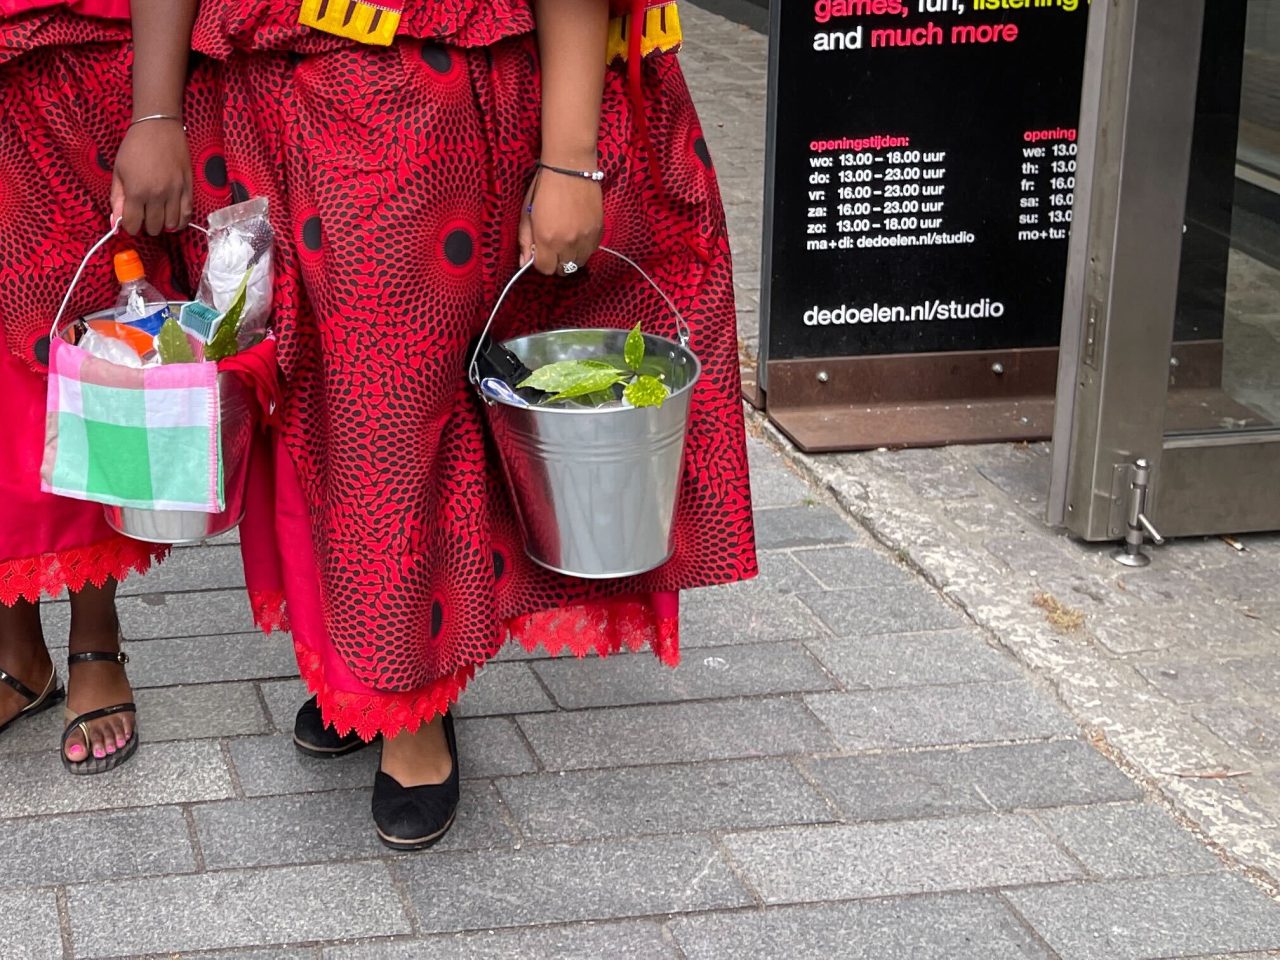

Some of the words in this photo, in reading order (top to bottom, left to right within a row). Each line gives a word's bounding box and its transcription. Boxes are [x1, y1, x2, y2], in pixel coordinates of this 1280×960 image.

[813, 26, 862, 50] and
[871, 22, 943, 47] much
[952, 24, 1018, 43] more
[1023, 127, 1077, 142] opening
[810, 135, 909, 152] openingstijden:
[1023, 148, 1045, 157] we:
[1051, 144, 1077, 157] 13.0
[810, 157, 833, 167] wo:
[839, 153, 873, 166] 13.00
[887, 151, 920, 163] 18.00
[923, 152, 945, 162] uur
[1022, 162, 1038, 174] th:
[1050, 160, 1076, 173] 13.0
[809, 172, 829, 184] do:
[838, 170, 872, 182] 13.00
[884, 167, 920, 180] 23.00
[923, 169, 945, 179] uur
[1021, 179, 1034, 190] fr:
[1049, 177, 1075, 190] 16.0
[809, 191, 825, 200] vr:
[838, 186, 871, 199] 16.00
[884, 184, 919, 197] 23.00
[922, 185, 944, 195] uur
[1020, 198, 1038, 207] sa:
[1048, 193, 1074, 206] 16.0
[808, 207, 826, 217] za:
[837, 203, 870, 215] 16.00
[884, 200, 918, 213] 23.00
[922, 202, 944, 212] uur
[1020, 214, 1038, 223] su:
[1047, 210, 1072, 223] 13.0
[807, 224, 826, 233] zo:
[837, 219, 870, 232] 13.00
[884, 217, 917, 230] 18.00
[920, 219, 942, 228] uur
[857, 231, 974, 247] dedoelen.nl/studio
[804, 299, 1004, 325] dedoelen.nl/studio
